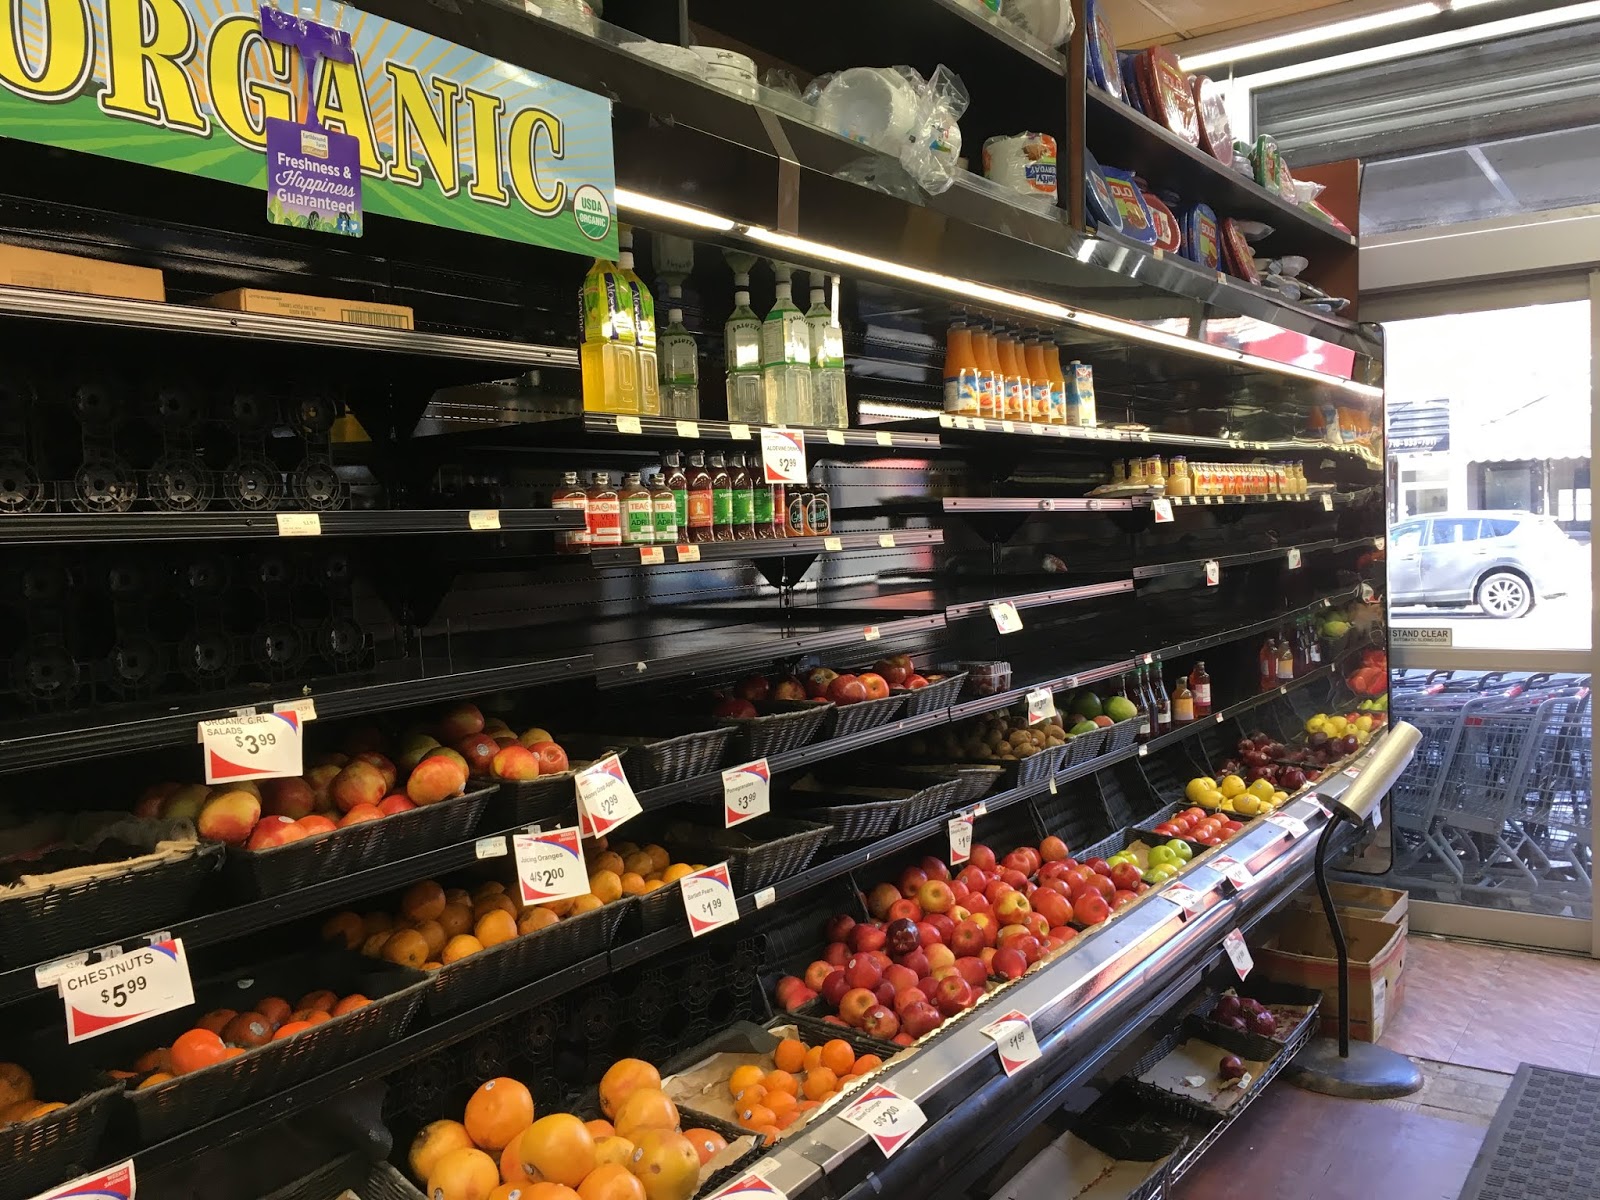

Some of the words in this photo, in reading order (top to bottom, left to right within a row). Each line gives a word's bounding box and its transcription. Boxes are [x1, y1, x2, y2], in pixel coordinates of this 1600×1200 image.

[0, 0, 570, 217] ORGANIC
[277, 152, 341, 177] Freshness
[343, 166, 352, 179] &
[275, 170, 356, 198] Happiness
[276, 188, 355, 214] Guaranteed
[581, 197, 602, 212] USDA
[579, 213, 606, 227] ORGANIC
[1392, 630, 1419, 638] STAND
[1421, 630, 1448, 638] CLEAR
[247, 714, 269, 725] GRL
[207, 727, 243, 736] SALADS
[521, 856, 537, 864] Juicing
[538, 852, 563, 861] Oranges
[67, 952, 154, 991] CHESTNUTS
